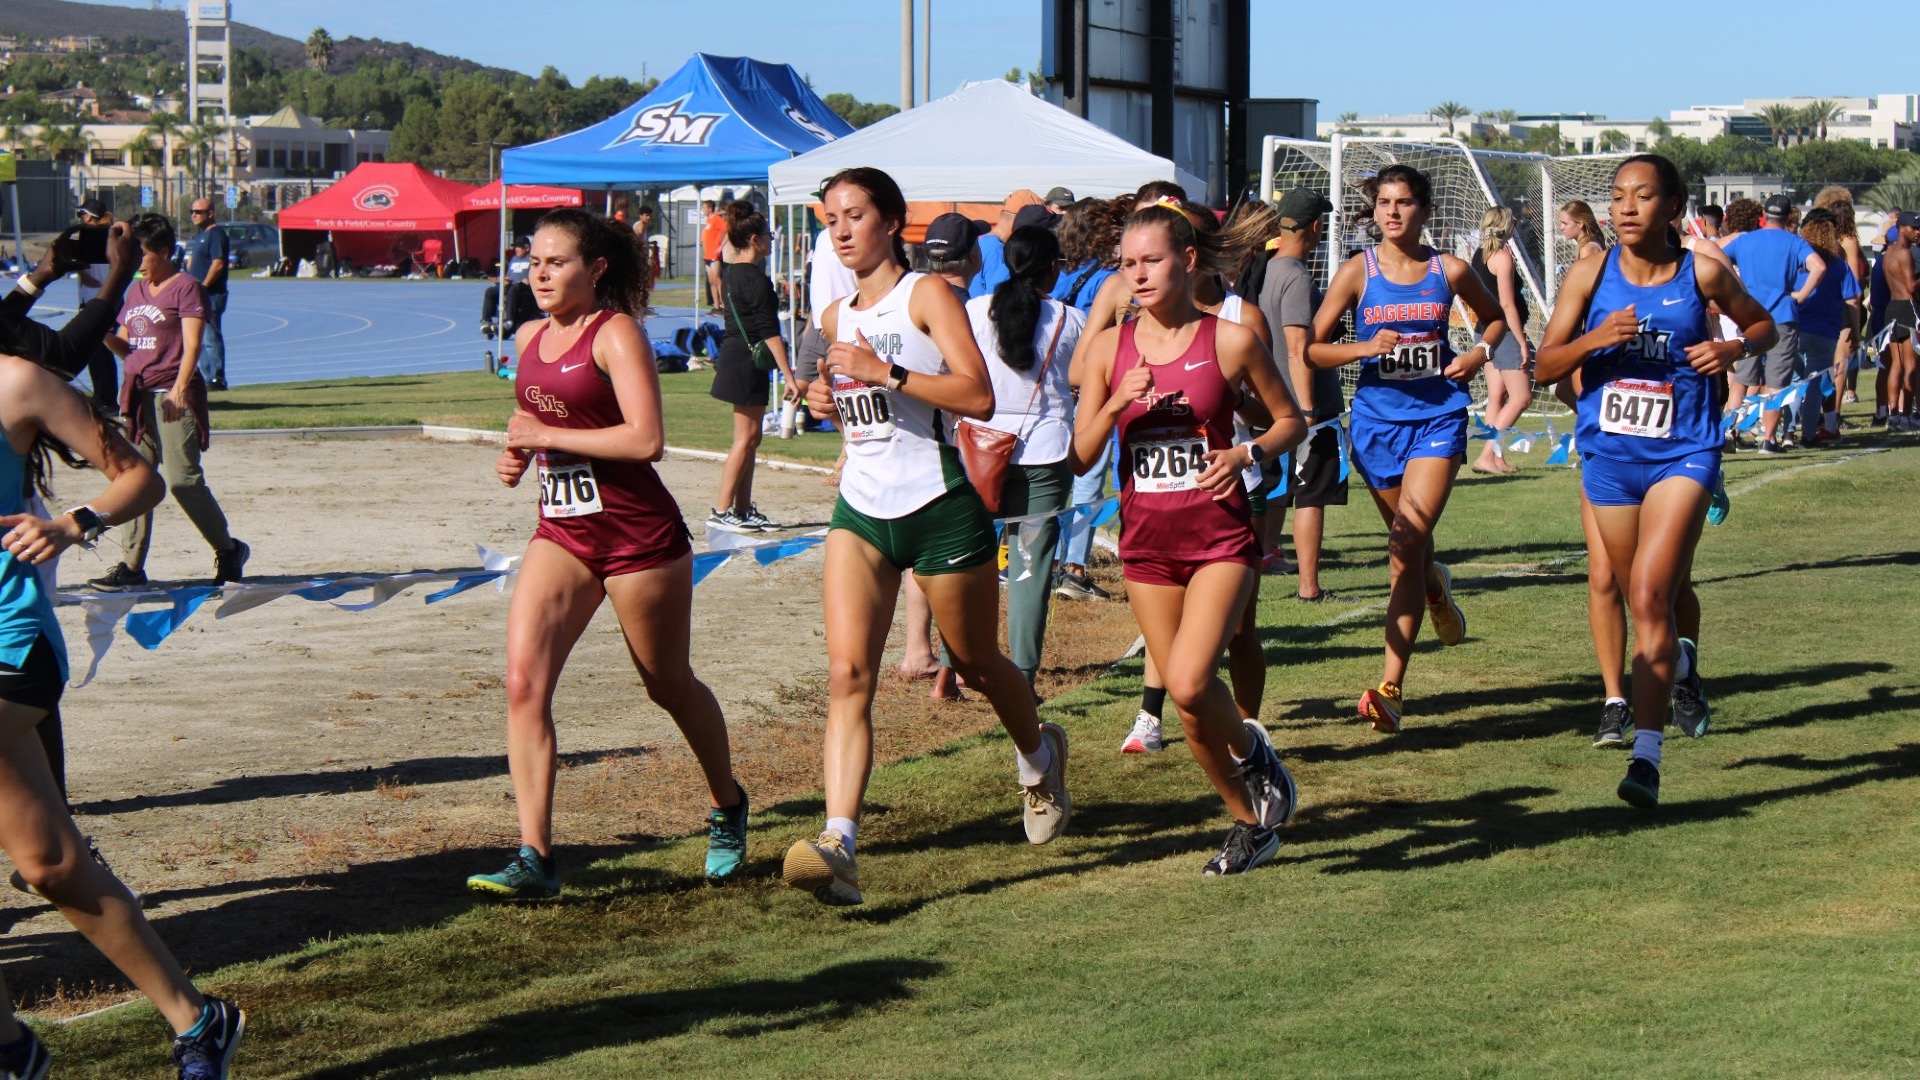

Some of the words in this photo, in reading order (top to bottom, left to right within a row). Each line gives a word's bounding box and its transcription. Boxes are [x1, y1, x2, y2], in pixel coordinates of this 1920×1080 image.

[611, 99, 723, 145] SM
[471, 198, 491, 206] Track
[501, 195, 541, 205] eld/Cross
[541, 194, 571, 204] Country
[315, 219, 335, 227] Track
[386, 219, 417, 229] Country
[125, 305, 166, 325] ESTMONT
[1364, 302, 1449, 325] SAGEHENS
[1380, 344, 1438, 373] 6461
[525, 386, 568, 417] CMS
[836, 392, 889, 427] 6400
[1605, 393, 1670, 428] 6477
[1134, 443, 1208, 479] 6264
[540, 469, 595, 506] 6276
[1156, 481, 1185, 490] MileSplit
